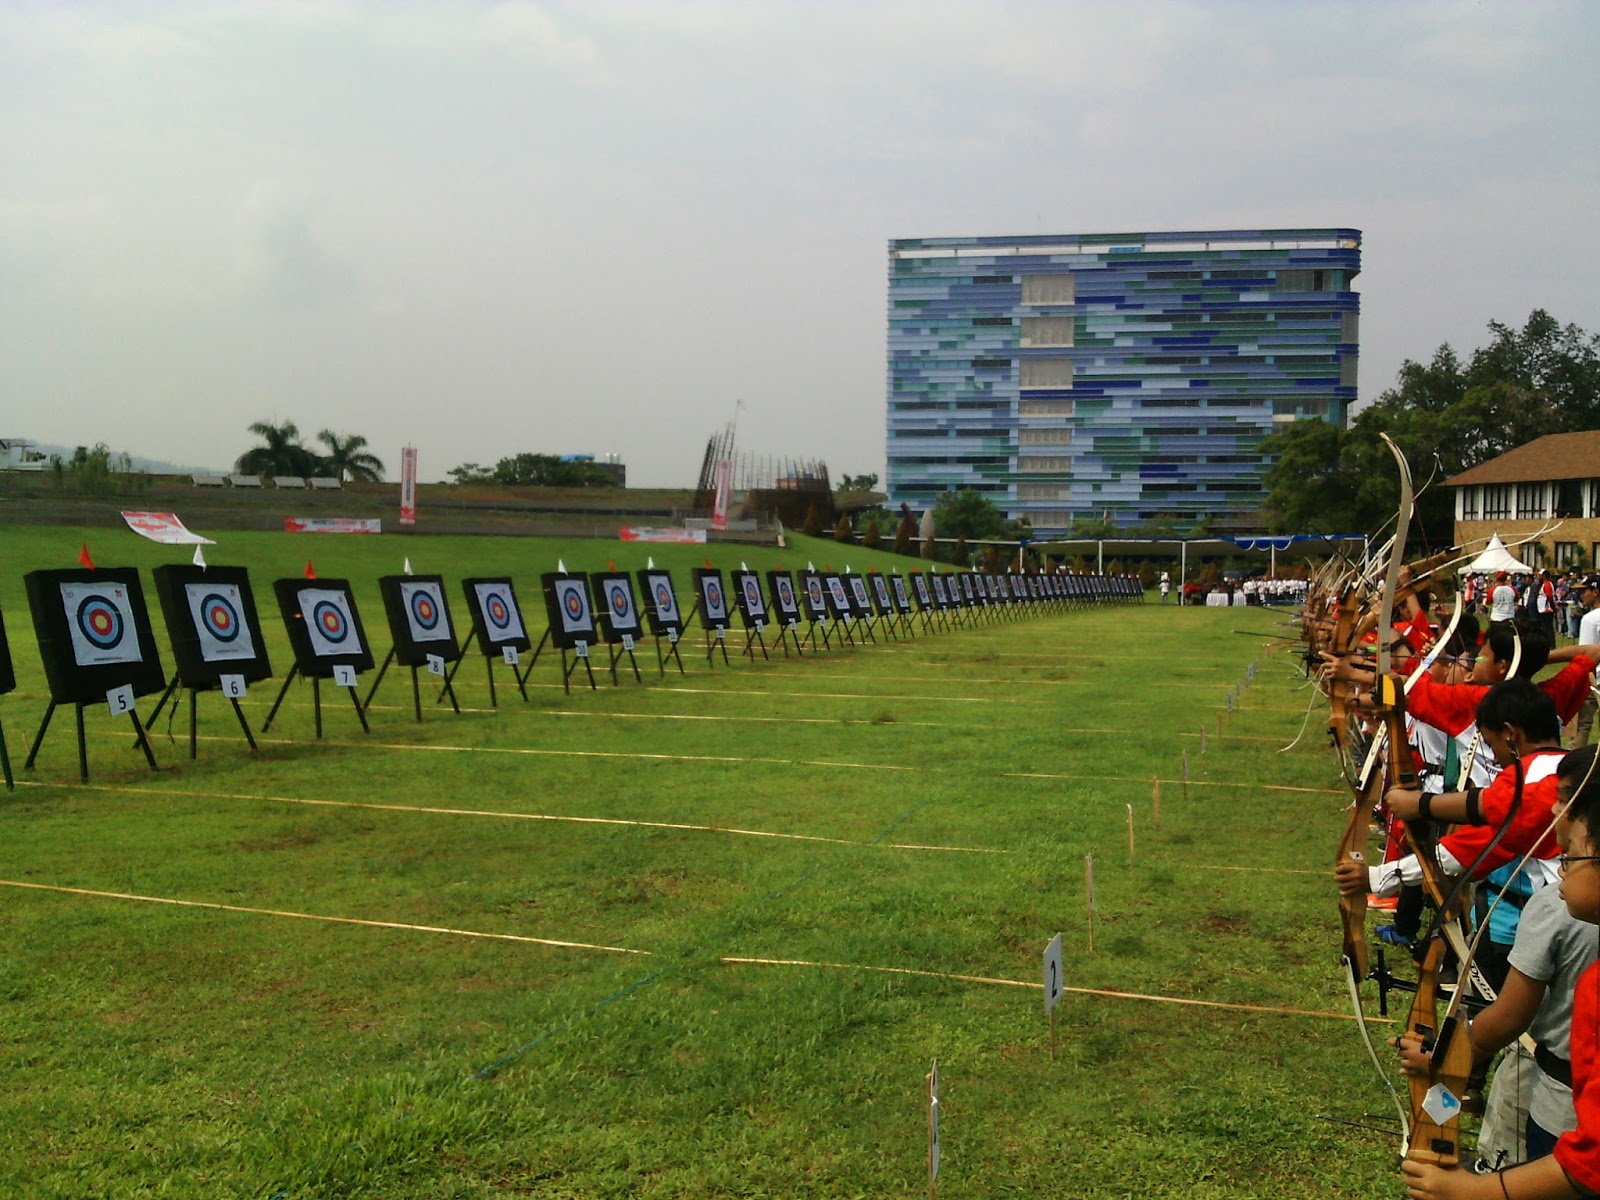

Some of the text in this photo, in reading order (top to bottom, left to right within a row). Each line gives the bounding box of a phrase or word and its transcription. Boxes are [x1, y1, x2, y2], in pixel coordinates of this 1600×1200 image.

[508, 651, 514, 662] 9
[433, 660, 439, 672] 8
[341, 671, 348, 684] 7
[230, 681, 238, 695] 6
[117, 694, 127, 710] 5
[1050, 959, 1058, 999] 2
